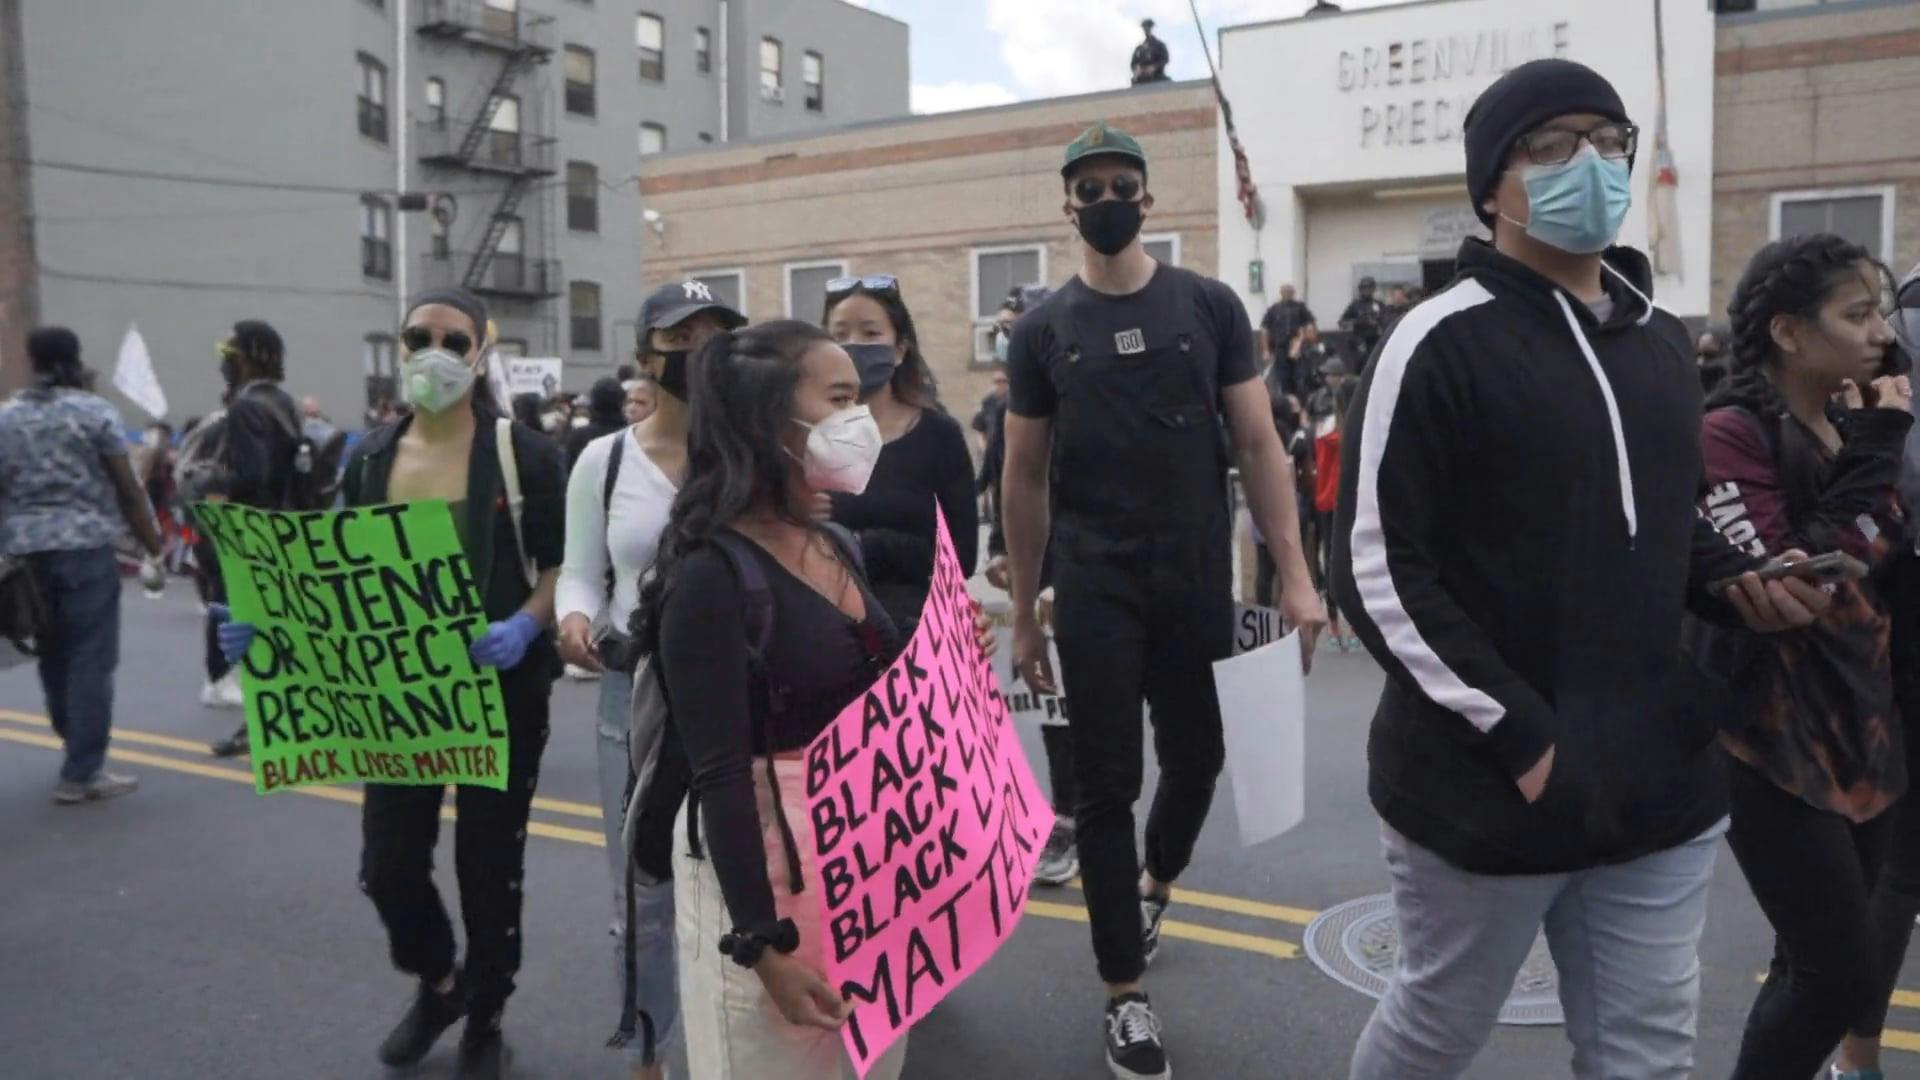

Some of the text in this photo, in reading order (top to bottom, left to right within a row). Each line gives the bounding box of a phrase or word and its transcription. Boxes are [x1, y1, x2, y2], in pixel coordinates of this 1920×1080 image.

[1359, 97, 1466, 149] PREC
[195, 503, 413, 569] RESPECT
[249, 554, 485, 632] EXISTENCE
[245, 617, 480, 687] OR EXPECT
[256, 678, 505, 748] RESISTANCE
[807, 637, 928, 799] BLACK
[263, 745, 500, 790] BLACK LIVES MATTER
[811, 683, 945, 856] BLACK
[821, 746, 958, 911] BLACK
[830, 808, 967, 964] BLACK
